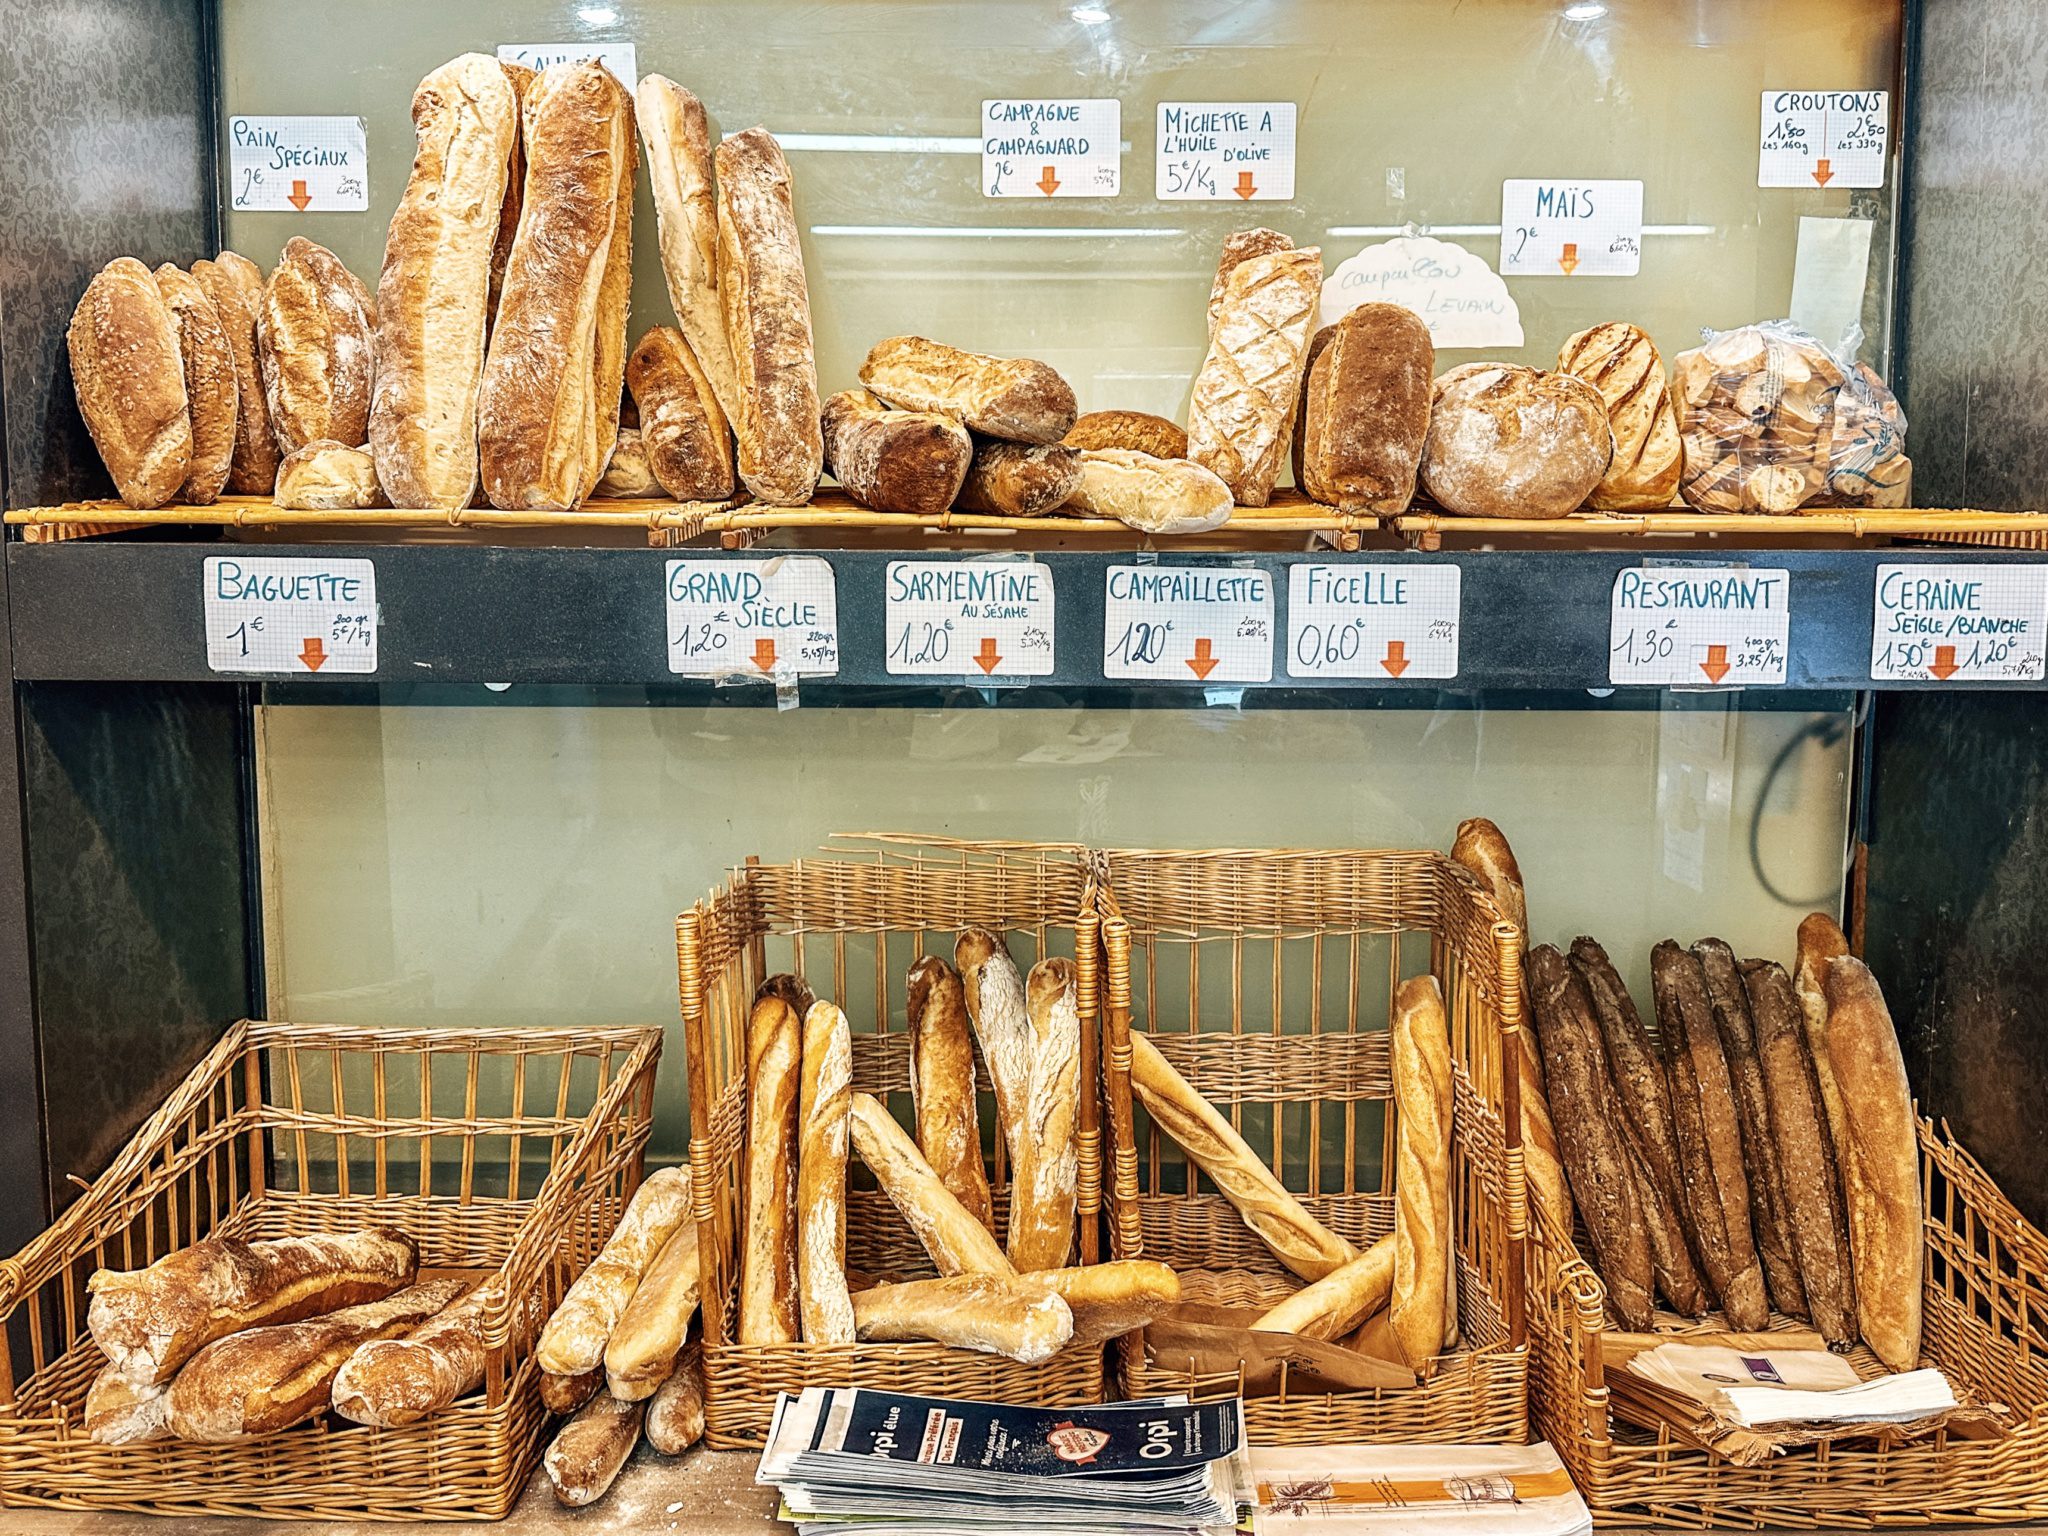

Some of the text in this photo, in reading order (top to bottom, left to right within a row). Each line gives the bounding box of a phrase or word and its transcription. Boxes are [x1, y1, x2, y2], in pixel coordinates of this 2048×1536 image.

[989, 102, 1080, 122] CAMPAGNE
[1774, 92, 1881, 113] CROUTONS
[1030, 121, 1040, 135] &
[1260, 111, 1272, 132] A
[986, 138, 1090, 156] CAMPAGNARD
[218, 561, 361, 601] BAGUETTE
[669, 564, 761, 603] GRAND
[1621, 572, 1780, 610] RESTAURANT
[961, 603, 1028, 619] AU SÉSAME
[883, 1407, 901, 1430] élue
[941, 1421, 959, 1461] Des Français
[1138, 1420, 1178, 1459] Orpi
[921, 1443, 935, 1464] arque
